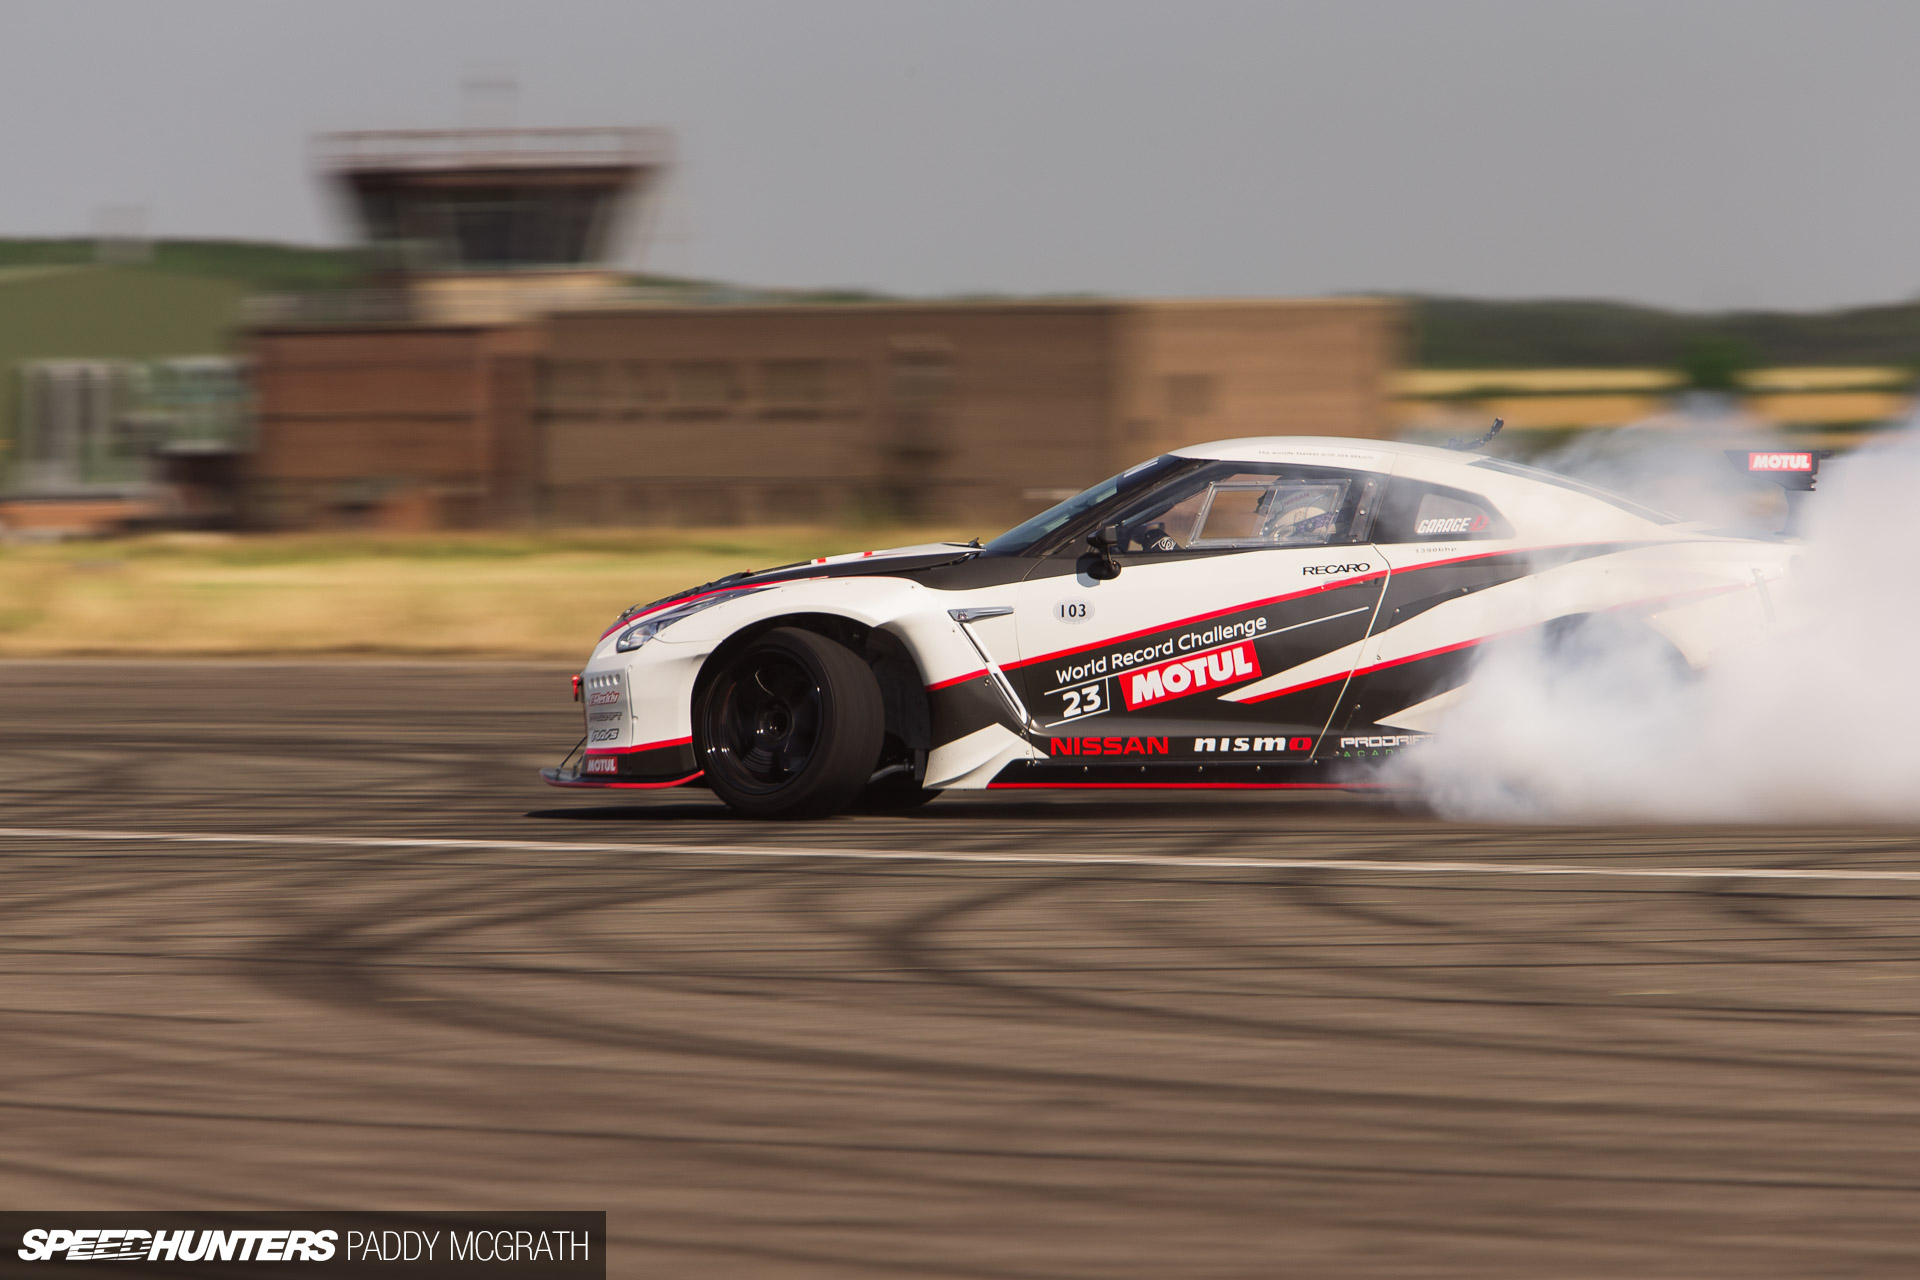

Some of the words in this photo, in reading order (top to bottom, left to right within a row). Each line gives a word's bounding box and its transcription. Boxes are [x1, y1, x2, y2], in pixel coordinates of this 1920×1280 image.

[1752, 454, 1810, 469] MOTUL
[1302, 562, 1371, 576] RECARO
[1061, 603, 1087, 618] 103
[1056, 656, 1107, 684] World
[1111, 638, 1174, 669] Record
[1178, 616, 1267, 651] Challenge
[1131, 646, 1253, 705] MOTUL
[1062, 684, 1102, 718] 23
[1050, 736, 1169, 755] NISSAN
[1193, 737, 1312, 752] nismo
[1343, 748, 1411, 758] ACADE
[587, 758, 616, 772] MOTUL
